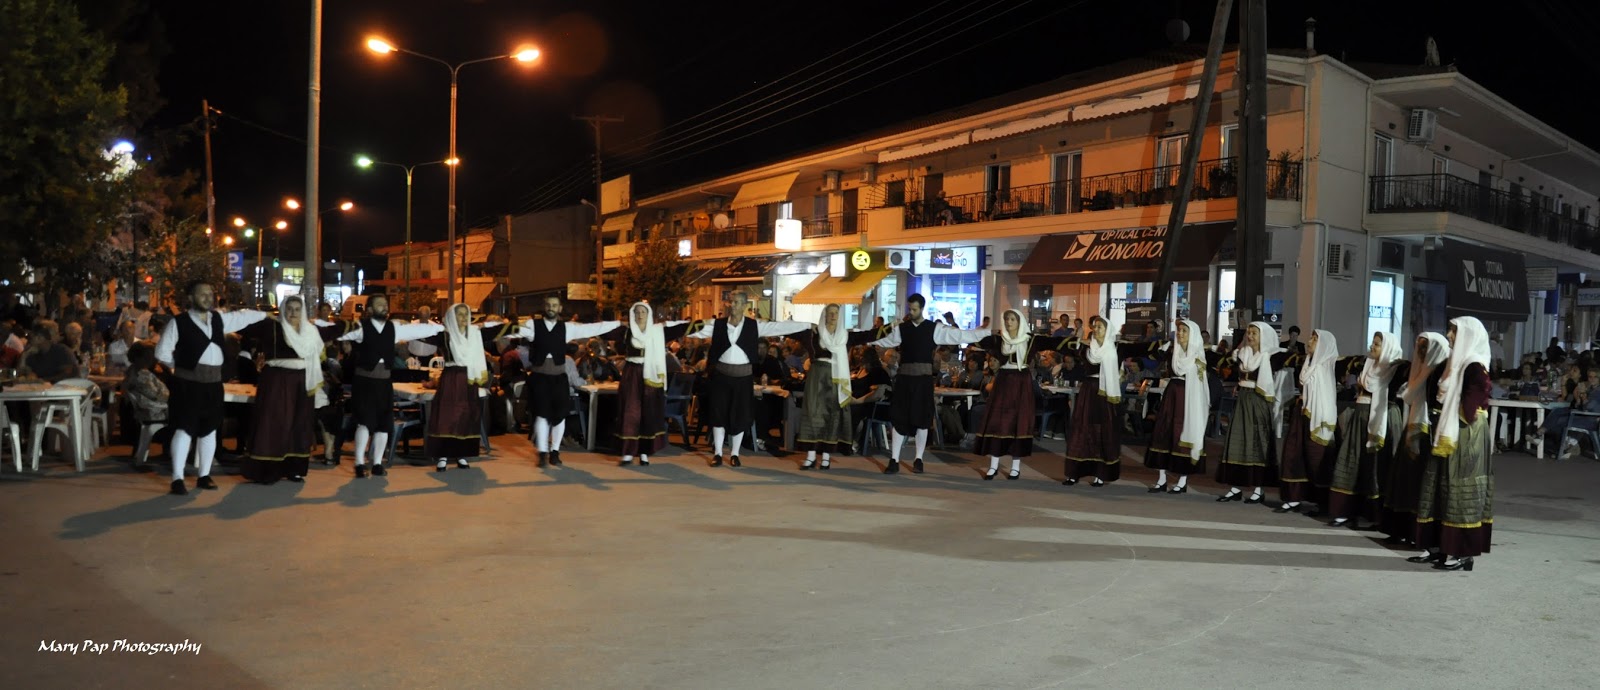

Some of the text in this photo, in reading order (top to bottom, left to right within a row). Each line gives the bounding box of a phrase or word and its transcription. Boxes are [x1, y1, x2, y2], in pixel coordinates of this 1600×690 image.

[1101, 227, 1168, 241] OPTICAL CENT
[1085, 241, 1163, 261] IKONOMO
